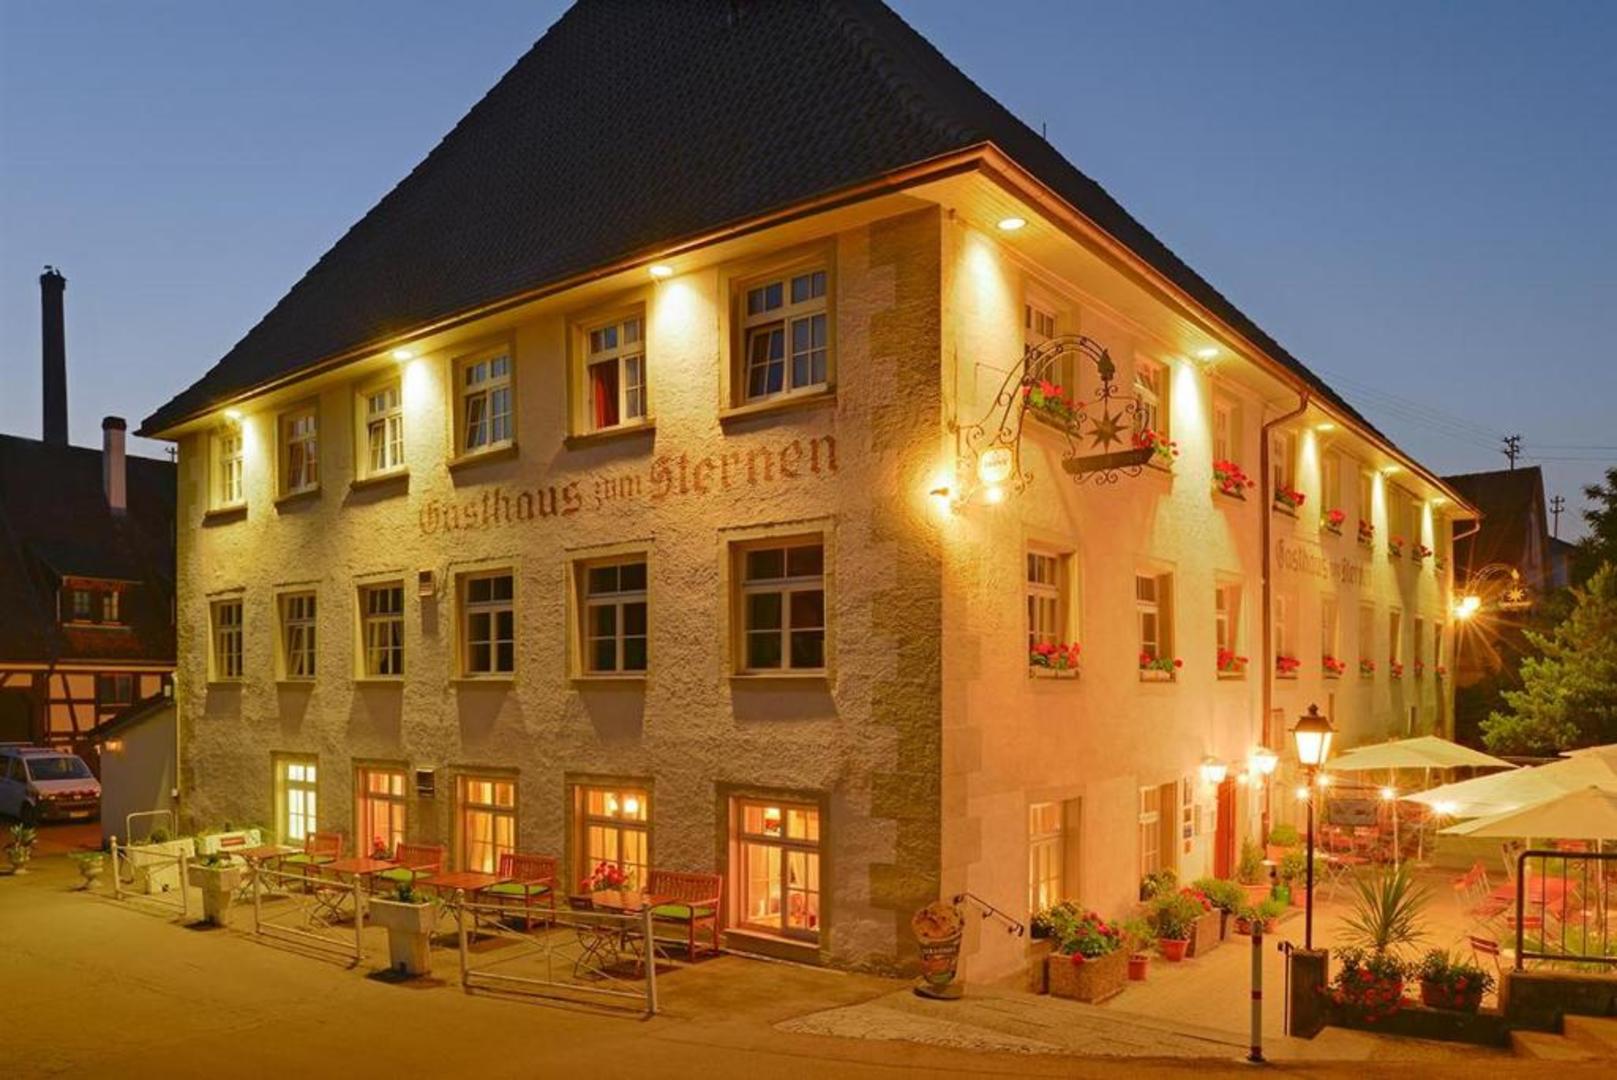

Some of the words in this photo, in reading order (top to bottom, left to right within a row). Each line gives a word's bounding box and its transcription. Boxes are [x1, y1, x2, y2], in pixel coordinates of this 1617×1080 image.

[419, 480, 583, 535] Gasthaus
[594, 474, 642, 508] zum
[650, 434, 839, 501] Sternen
